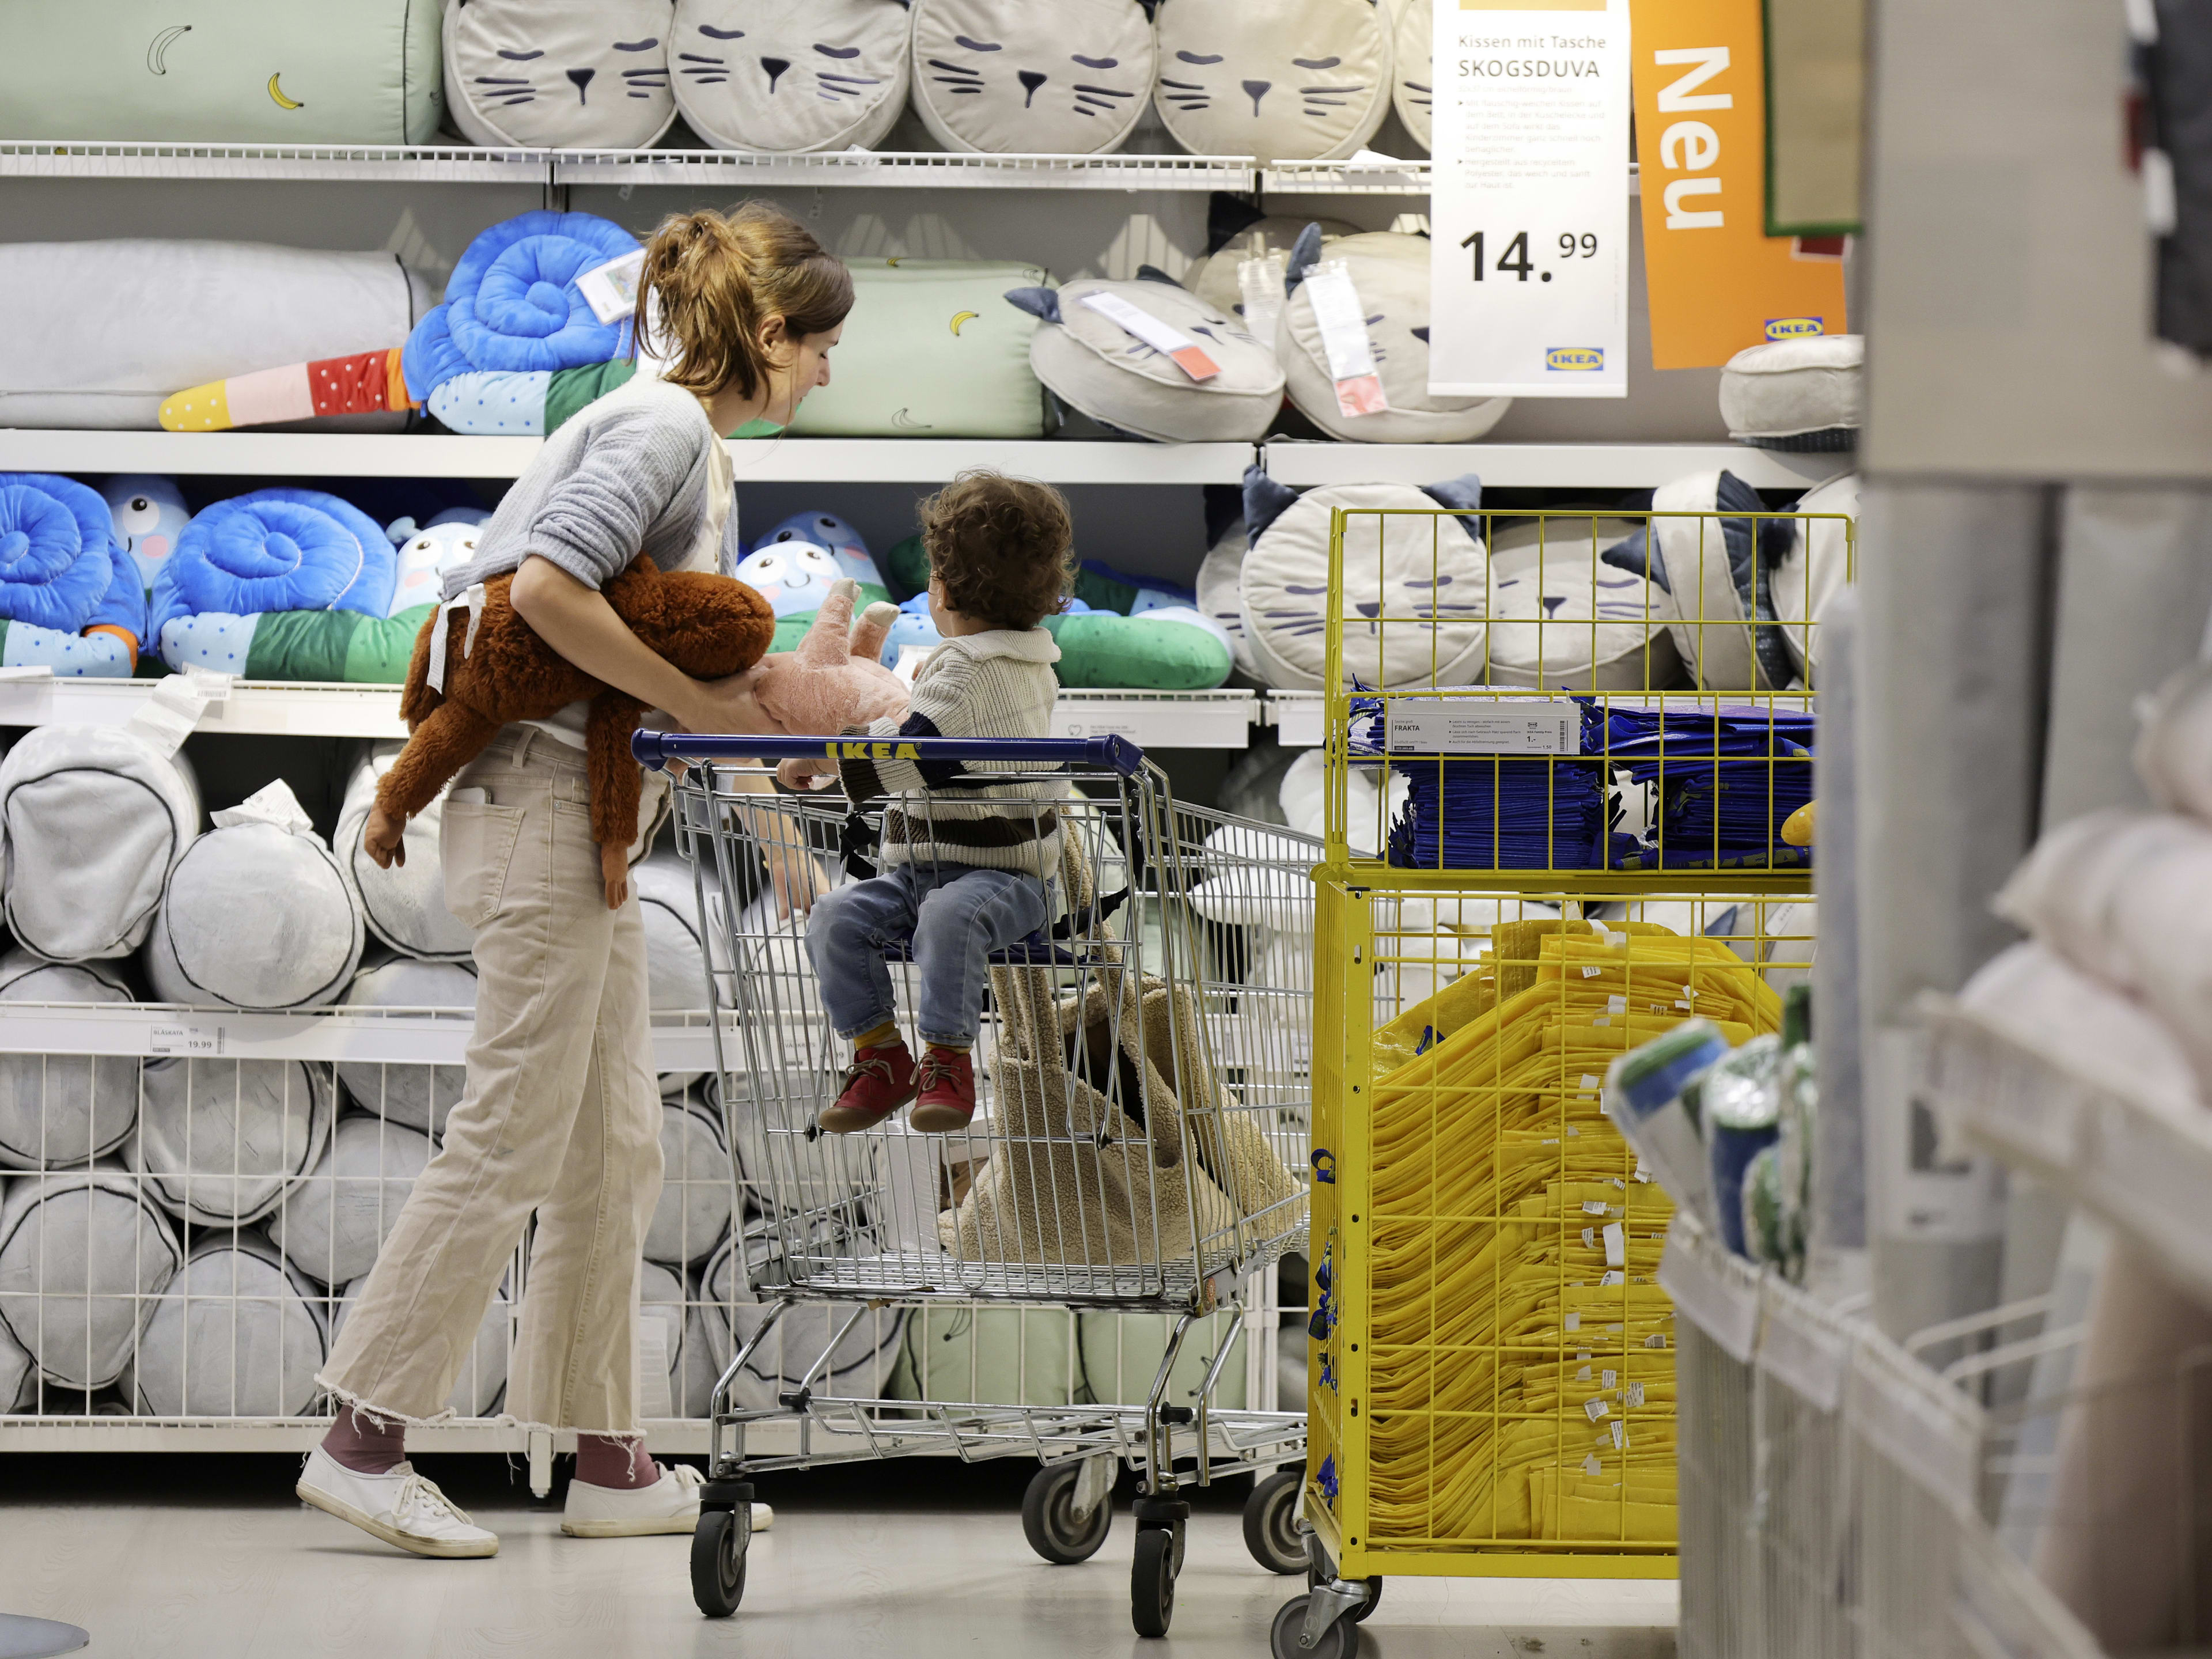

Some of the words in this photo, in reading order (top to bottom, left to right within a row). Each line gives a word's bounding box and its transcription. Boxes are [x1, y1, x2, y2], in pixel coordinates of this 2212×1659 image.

[1459, 35, 1511, 48] Kissen
[1517, 35, 1544, 48] mit
[1551, 36, 1606, 48] Tasche
[1459, 60, 1600, 77] SKOGSDUVA
[1654, 46, 1733, 230] Neu
[825, 743, 922, 760] IKEA
[188, 1040, 212, 1048] 19.99
